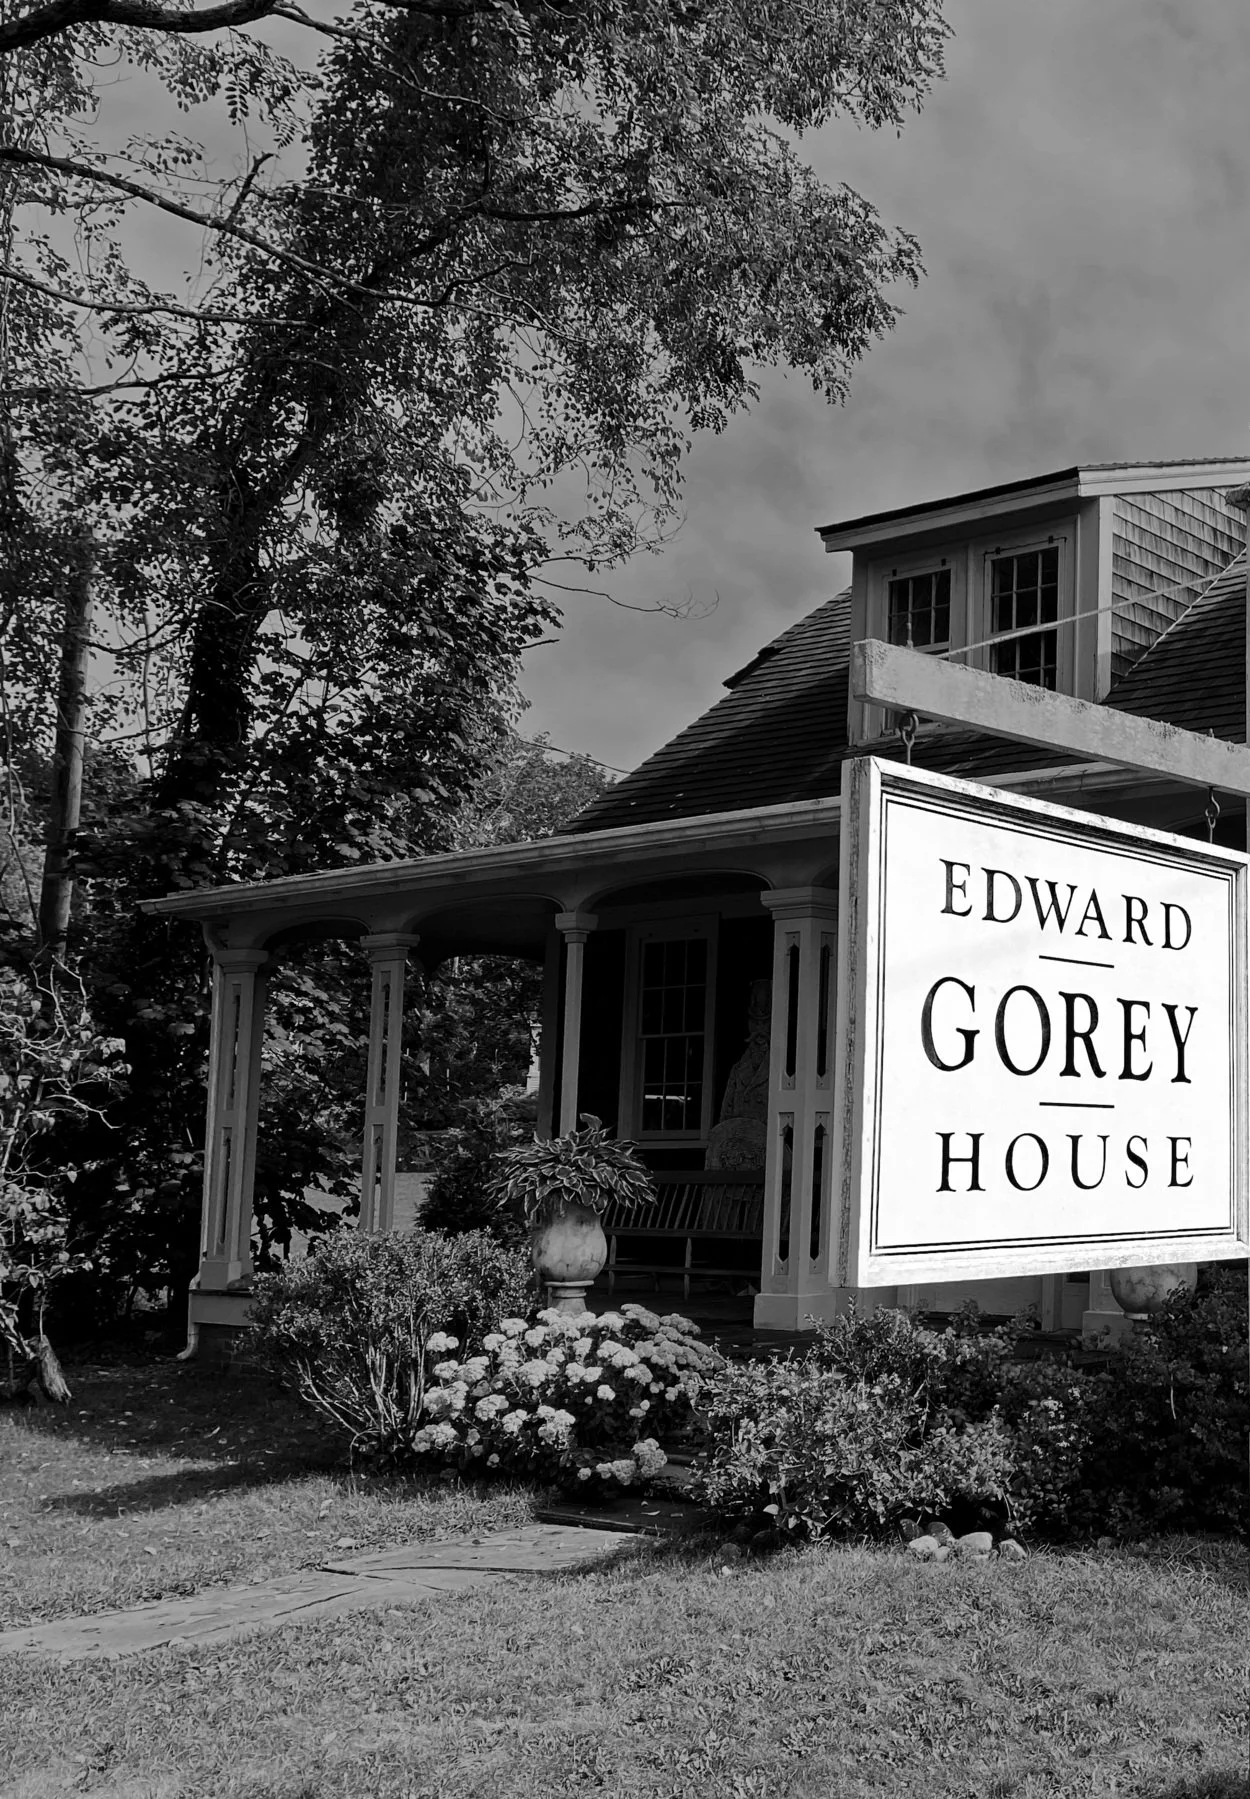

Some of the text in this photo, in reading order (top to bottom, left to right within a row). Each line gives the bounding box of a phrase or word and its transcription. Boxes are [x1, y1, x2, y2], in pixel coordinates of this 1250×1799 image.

[939, 858, 1192, 951] EDWARD
[921, 976, 1199, 1084] GOREY
[935, 1132, 1194, 1193] HOUSE
